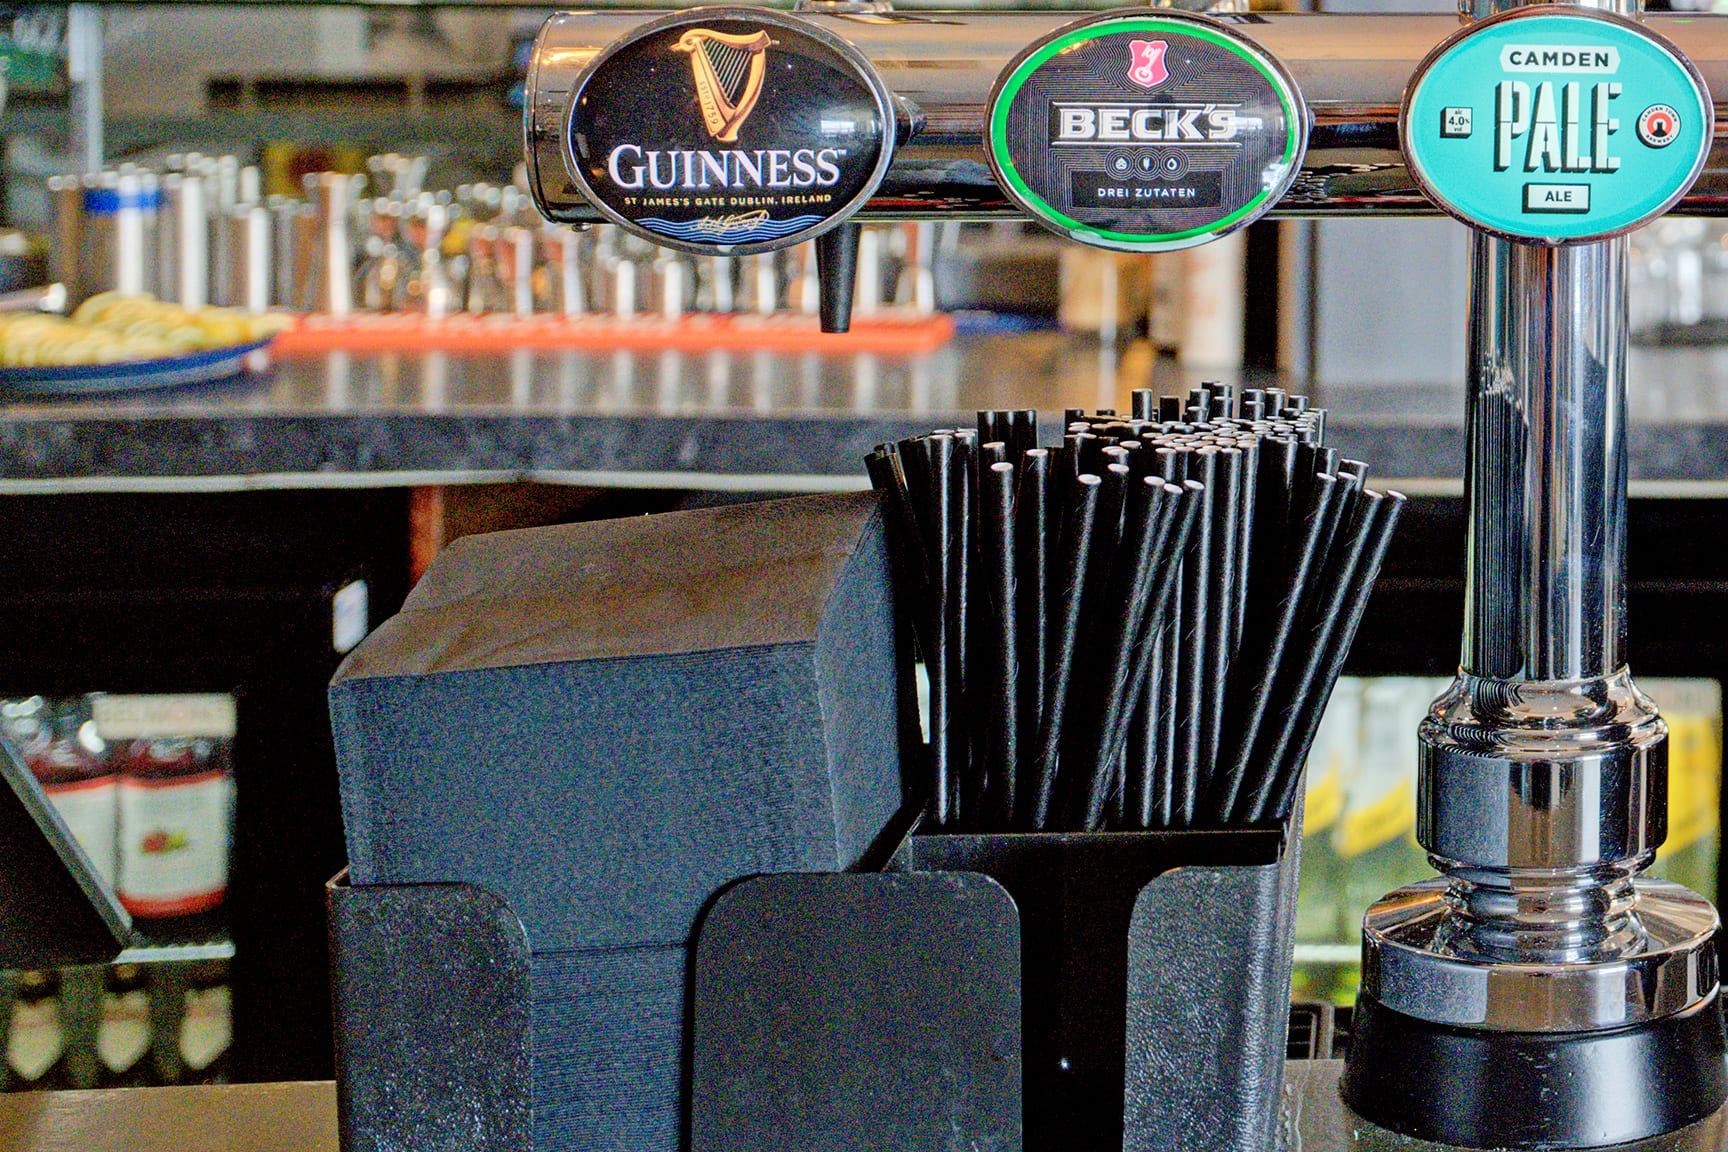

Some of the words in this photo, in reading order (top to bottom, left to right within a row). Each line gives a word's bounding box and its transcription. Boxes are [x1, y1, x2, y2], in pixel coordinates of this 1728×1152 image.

[1509, 51, 1609, 67] CAMDEN
[1059, 105, 1237, 140] BECK'S
[1494, 81, 1622, 173] PALE
[608, 144, 841, 190] GUINNESS
[624, 197, 637, 205] ST
[643, 197, 690, 206] JAMES'S
[695, 197, 725, 206] GATE
[781, 194, 832, 206] IRELAND
[1097, 188, 1130, 197] DREI
[1135, 188, 1196, 197] ZUTATEN
[1545, 191, 1572, 202] ALE
